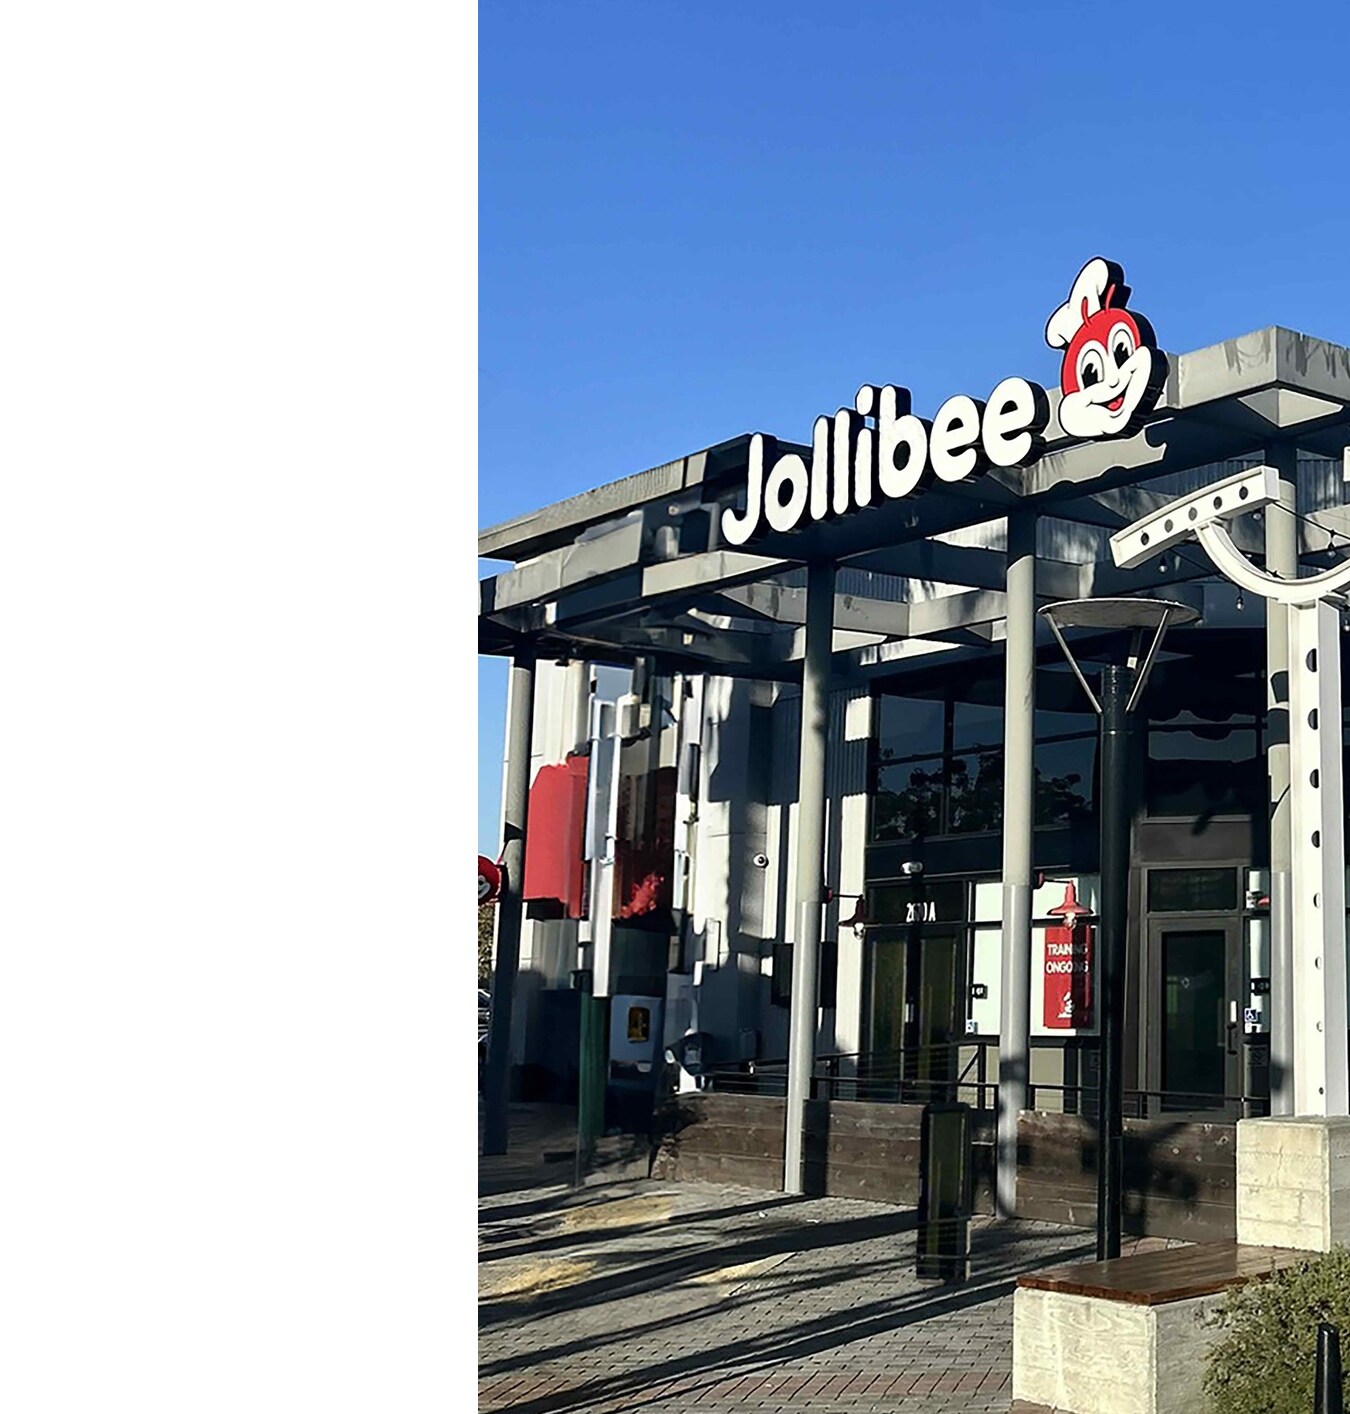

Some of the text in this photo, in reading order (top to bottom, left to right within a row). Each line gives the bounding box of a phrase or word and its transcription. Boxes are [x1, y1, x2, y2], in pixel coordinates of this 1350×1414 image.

[720, 376, 1038, 547] Jollibee
[1047, 943, 1088, 956] TRAINING
[1045, 961, 1089, 974] ONGOING
